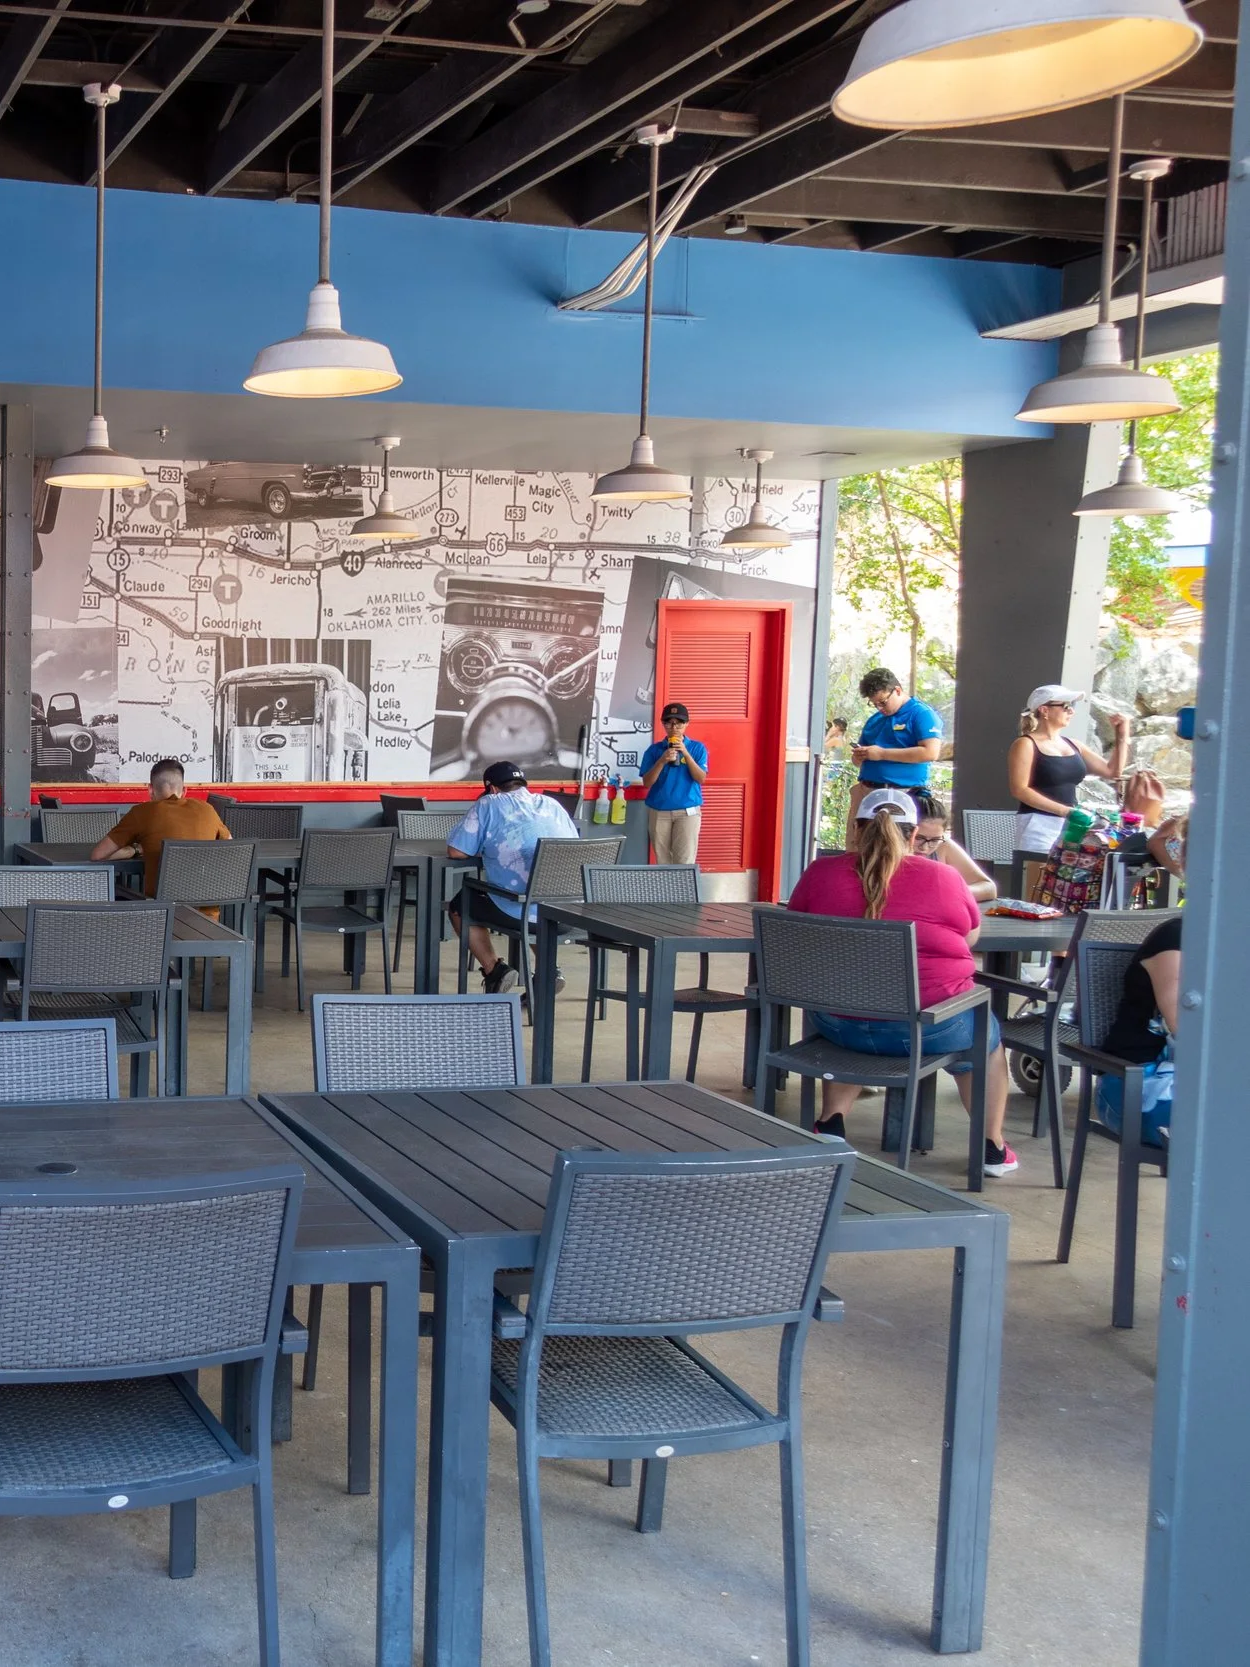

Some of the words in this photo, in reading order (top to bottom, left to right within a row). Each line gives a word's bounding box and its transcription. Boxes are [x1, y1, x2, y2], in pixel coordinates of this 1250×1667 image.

[161, 470, 178, 481] 293
[381, 468, 434, 481] enworth
[475, 474, 525, 487] Kellerville
[529, 484, 561, 498] Magic
[116, 503, 126, 513] 10
[155, 500, 174, 519] T
[507, 509, 523, 519] 453
[532, 501, 554, 515] City
[601, 505, 634, 519] Twitty
[439, 513, 455, 523] 273
[729, 511, 741, 523] 30
[114, 520, 162, 535] Conway
[240, 527, 277, 541] Groom
[540, 527, 558, 540] 20
[516, 532, 525, 541] 15
[647, 535, 656, 544] 15
[663, 531, 681, 544] 38
[490, 538, 504, 551] 66
[113, 552, 126, 566] 15
[343, 555, 361, 572] 40
[375, 557, 422, 570] Alanreed
[444, 551, 490, 565] McLean
[526, 553, 547, 565] Lela
[601, 554, 634, 567] Sham
[248, 565, 266, 578] 16
[741, 563, 768, 576] Erick
[191, 578, 208, 589] 294
[270, 573, 311, 586] Jericho
[124, 580, 165, 593] Claude
[220, 581, 237, 600] T
[367, 591, 425, 605] AMARILLO
[168, 606, 189, 623] 59
[323, 608, 333, 617] 18
[372, 607, 391, 617] 262
[395, 604, 421, 614] Miles
[143, 617, 152, 627] 12
[201, 616, 262, 632] Goodnight
[328, 619, 393, 633] OKLAHOMA
[377, 697, 401, 709] Lelia
[377, 711, 402, 722] Lake
[375, 735, 412, 750] Hedley
[619, 753, 635, 764] 338
[255, 763, 269, 771] THIS
[273, 763, 289, 771] SALE
